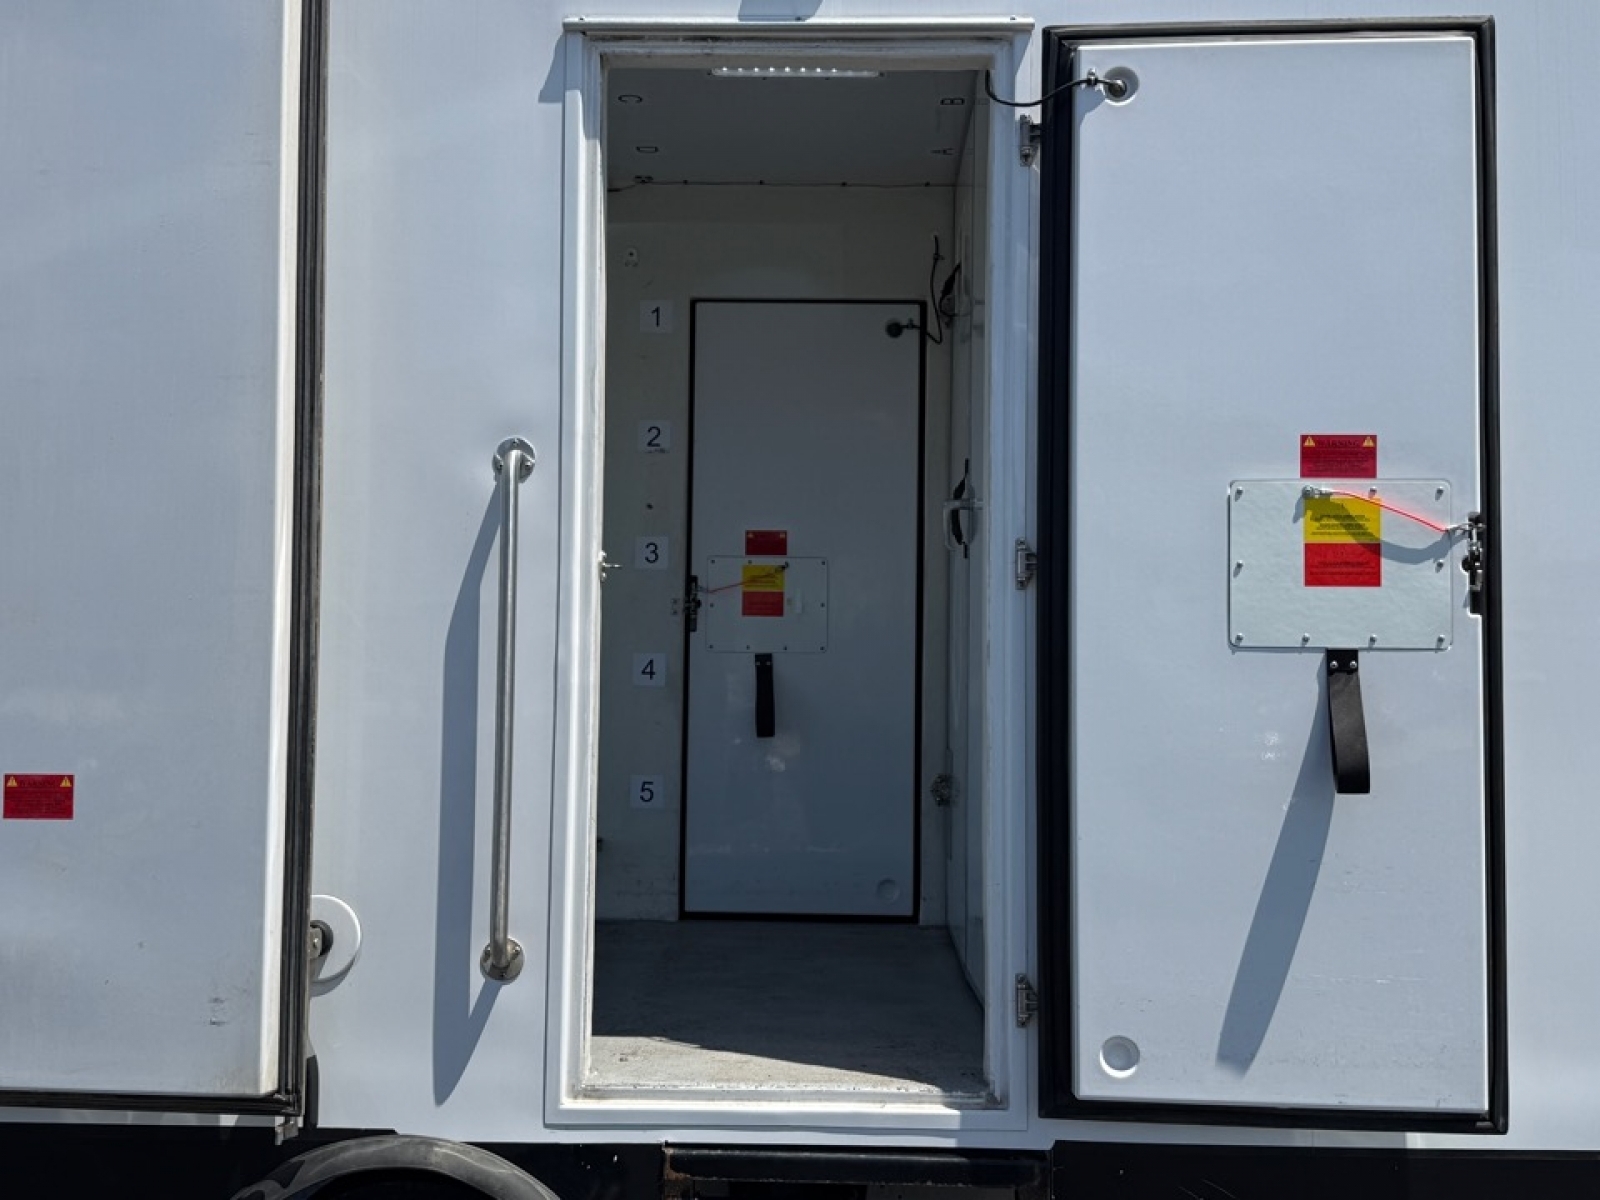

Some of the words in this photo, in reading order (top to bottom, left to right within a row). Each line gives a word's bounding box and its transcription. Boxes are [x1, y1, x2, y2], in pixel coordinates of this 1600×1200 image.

[940, 97, 965, 106] B
[930, 147, 954, 156] A
[652, 307, 660, 328] 1
[646, 426, 661, 447] 2
[644, 542, 659, 564] 3
[641, 659, 656, 681] 4
[639, 781, 654, 803] 5
